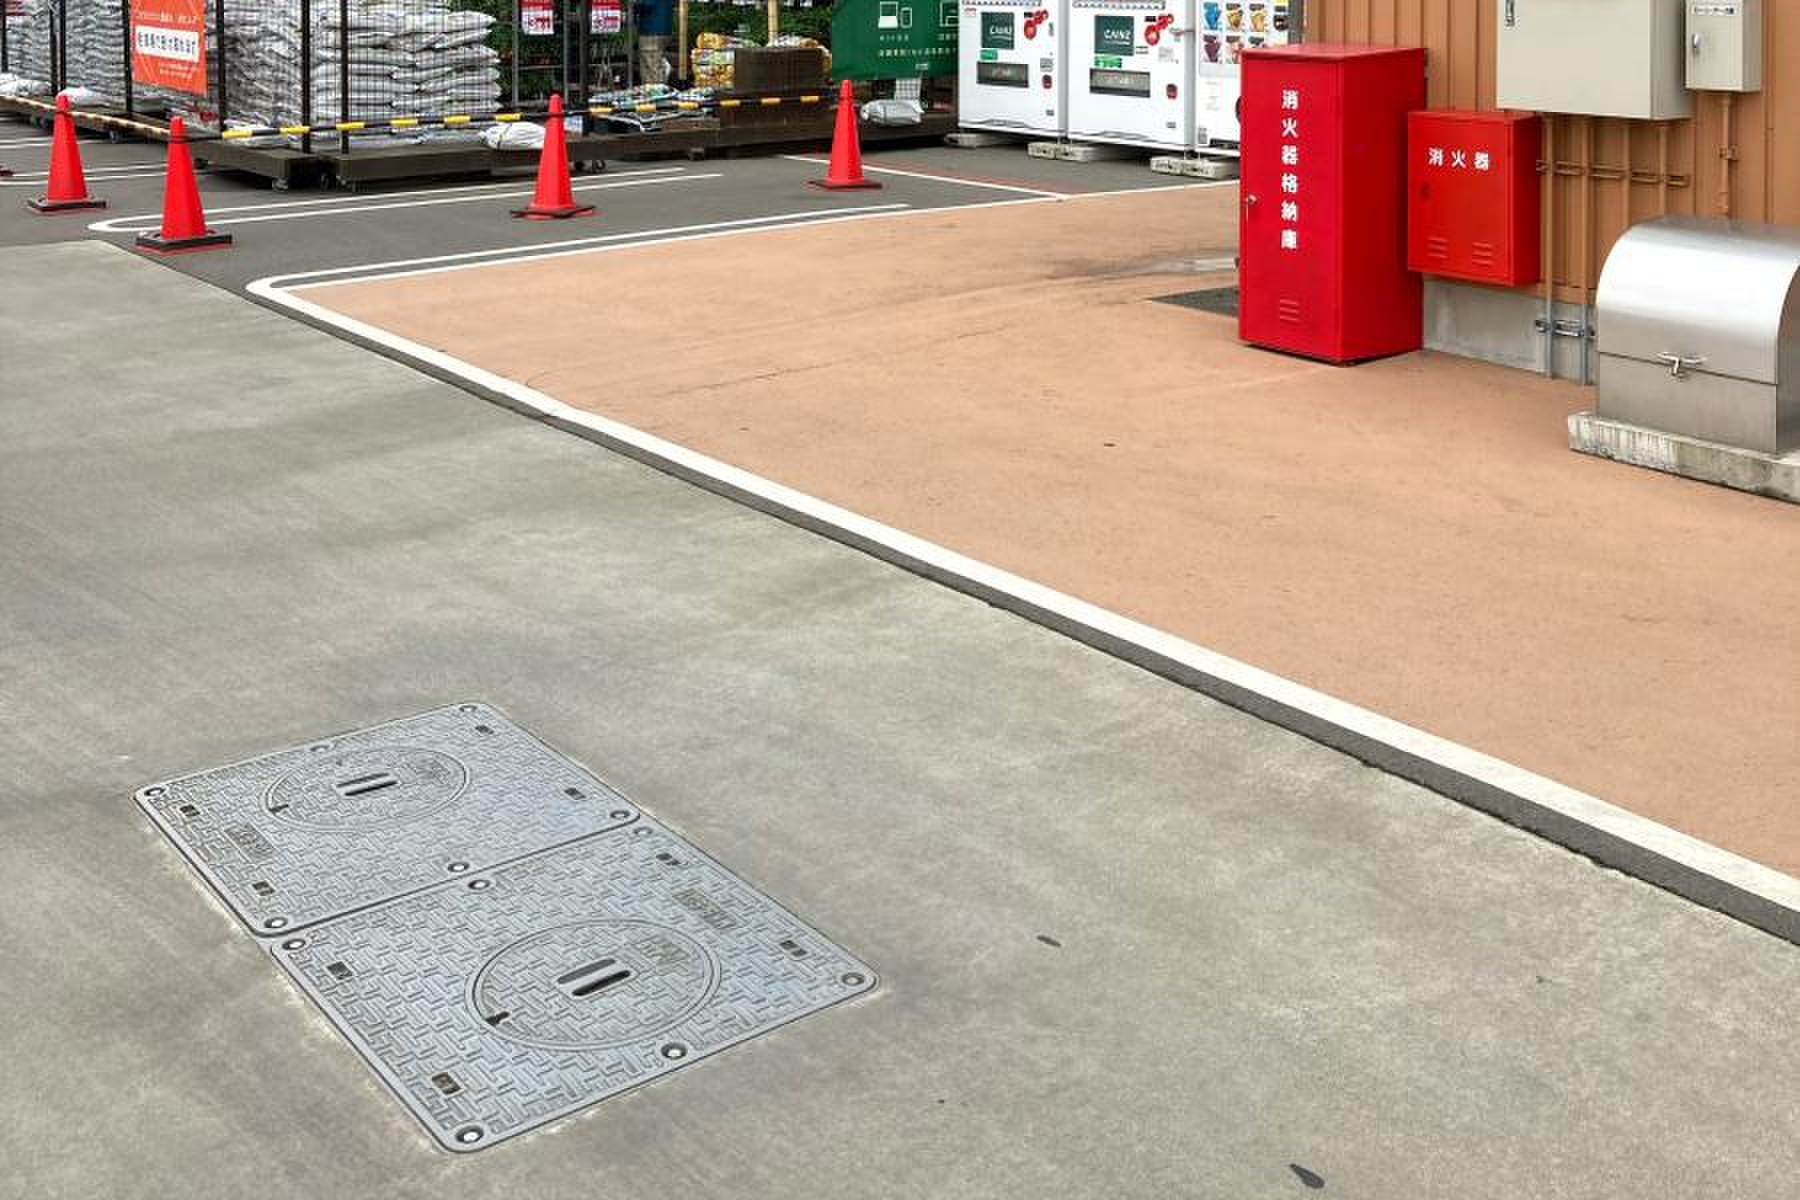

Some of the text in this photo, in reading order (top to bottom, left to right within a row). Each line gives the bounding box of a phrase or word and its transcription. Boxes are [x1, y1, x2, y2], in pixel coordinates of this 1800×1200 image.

[1281, 89, 1299, 250] 消火器格納庫
[1427, 146, 1489, 171] 消火器
